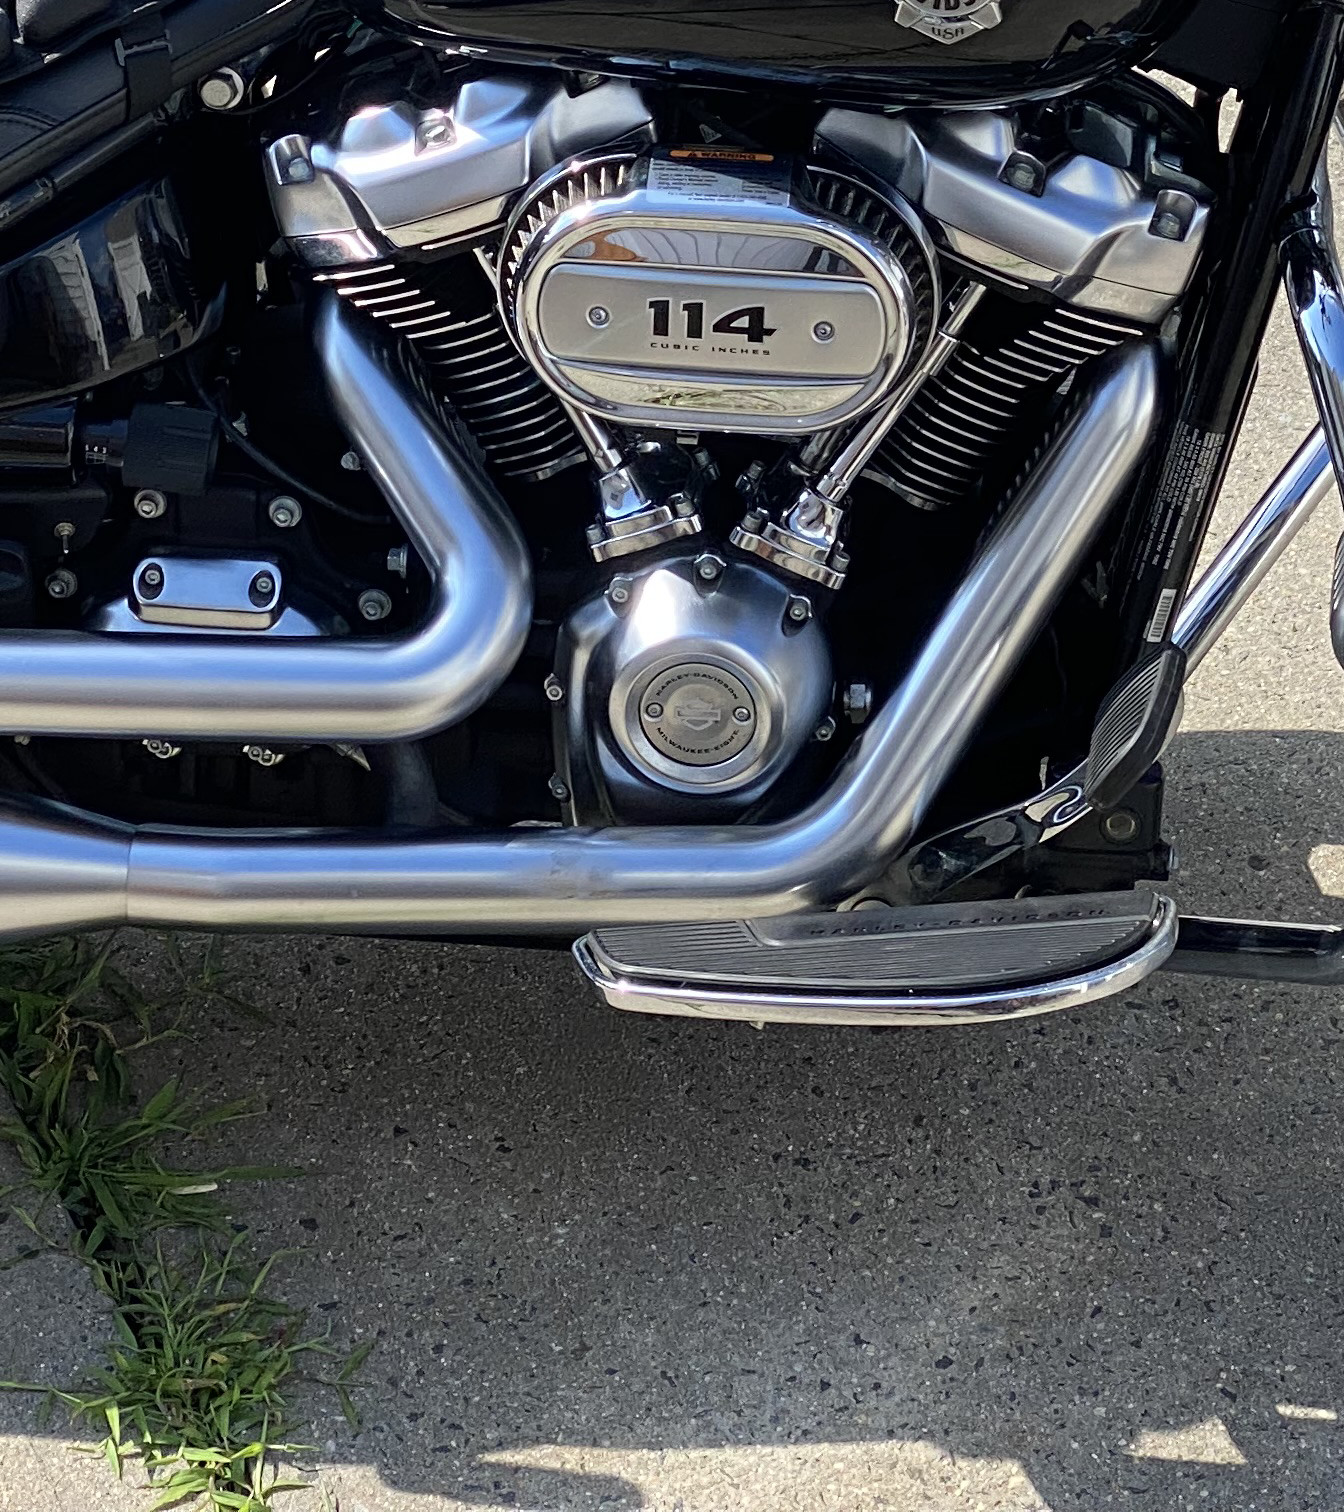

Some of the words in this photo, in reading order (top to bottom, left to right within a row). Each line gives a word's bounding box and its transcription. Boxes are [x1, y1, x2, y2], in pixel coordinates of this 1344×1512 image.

[701, 152, 757, 161] WARNING
[646, 297, 779, 344] 114
[650, 341, 701, 352] CUBIC
[711, 345, 772, 356] INCHES
[656, 672, 740, 700] HARLEY-DAVIDSON
